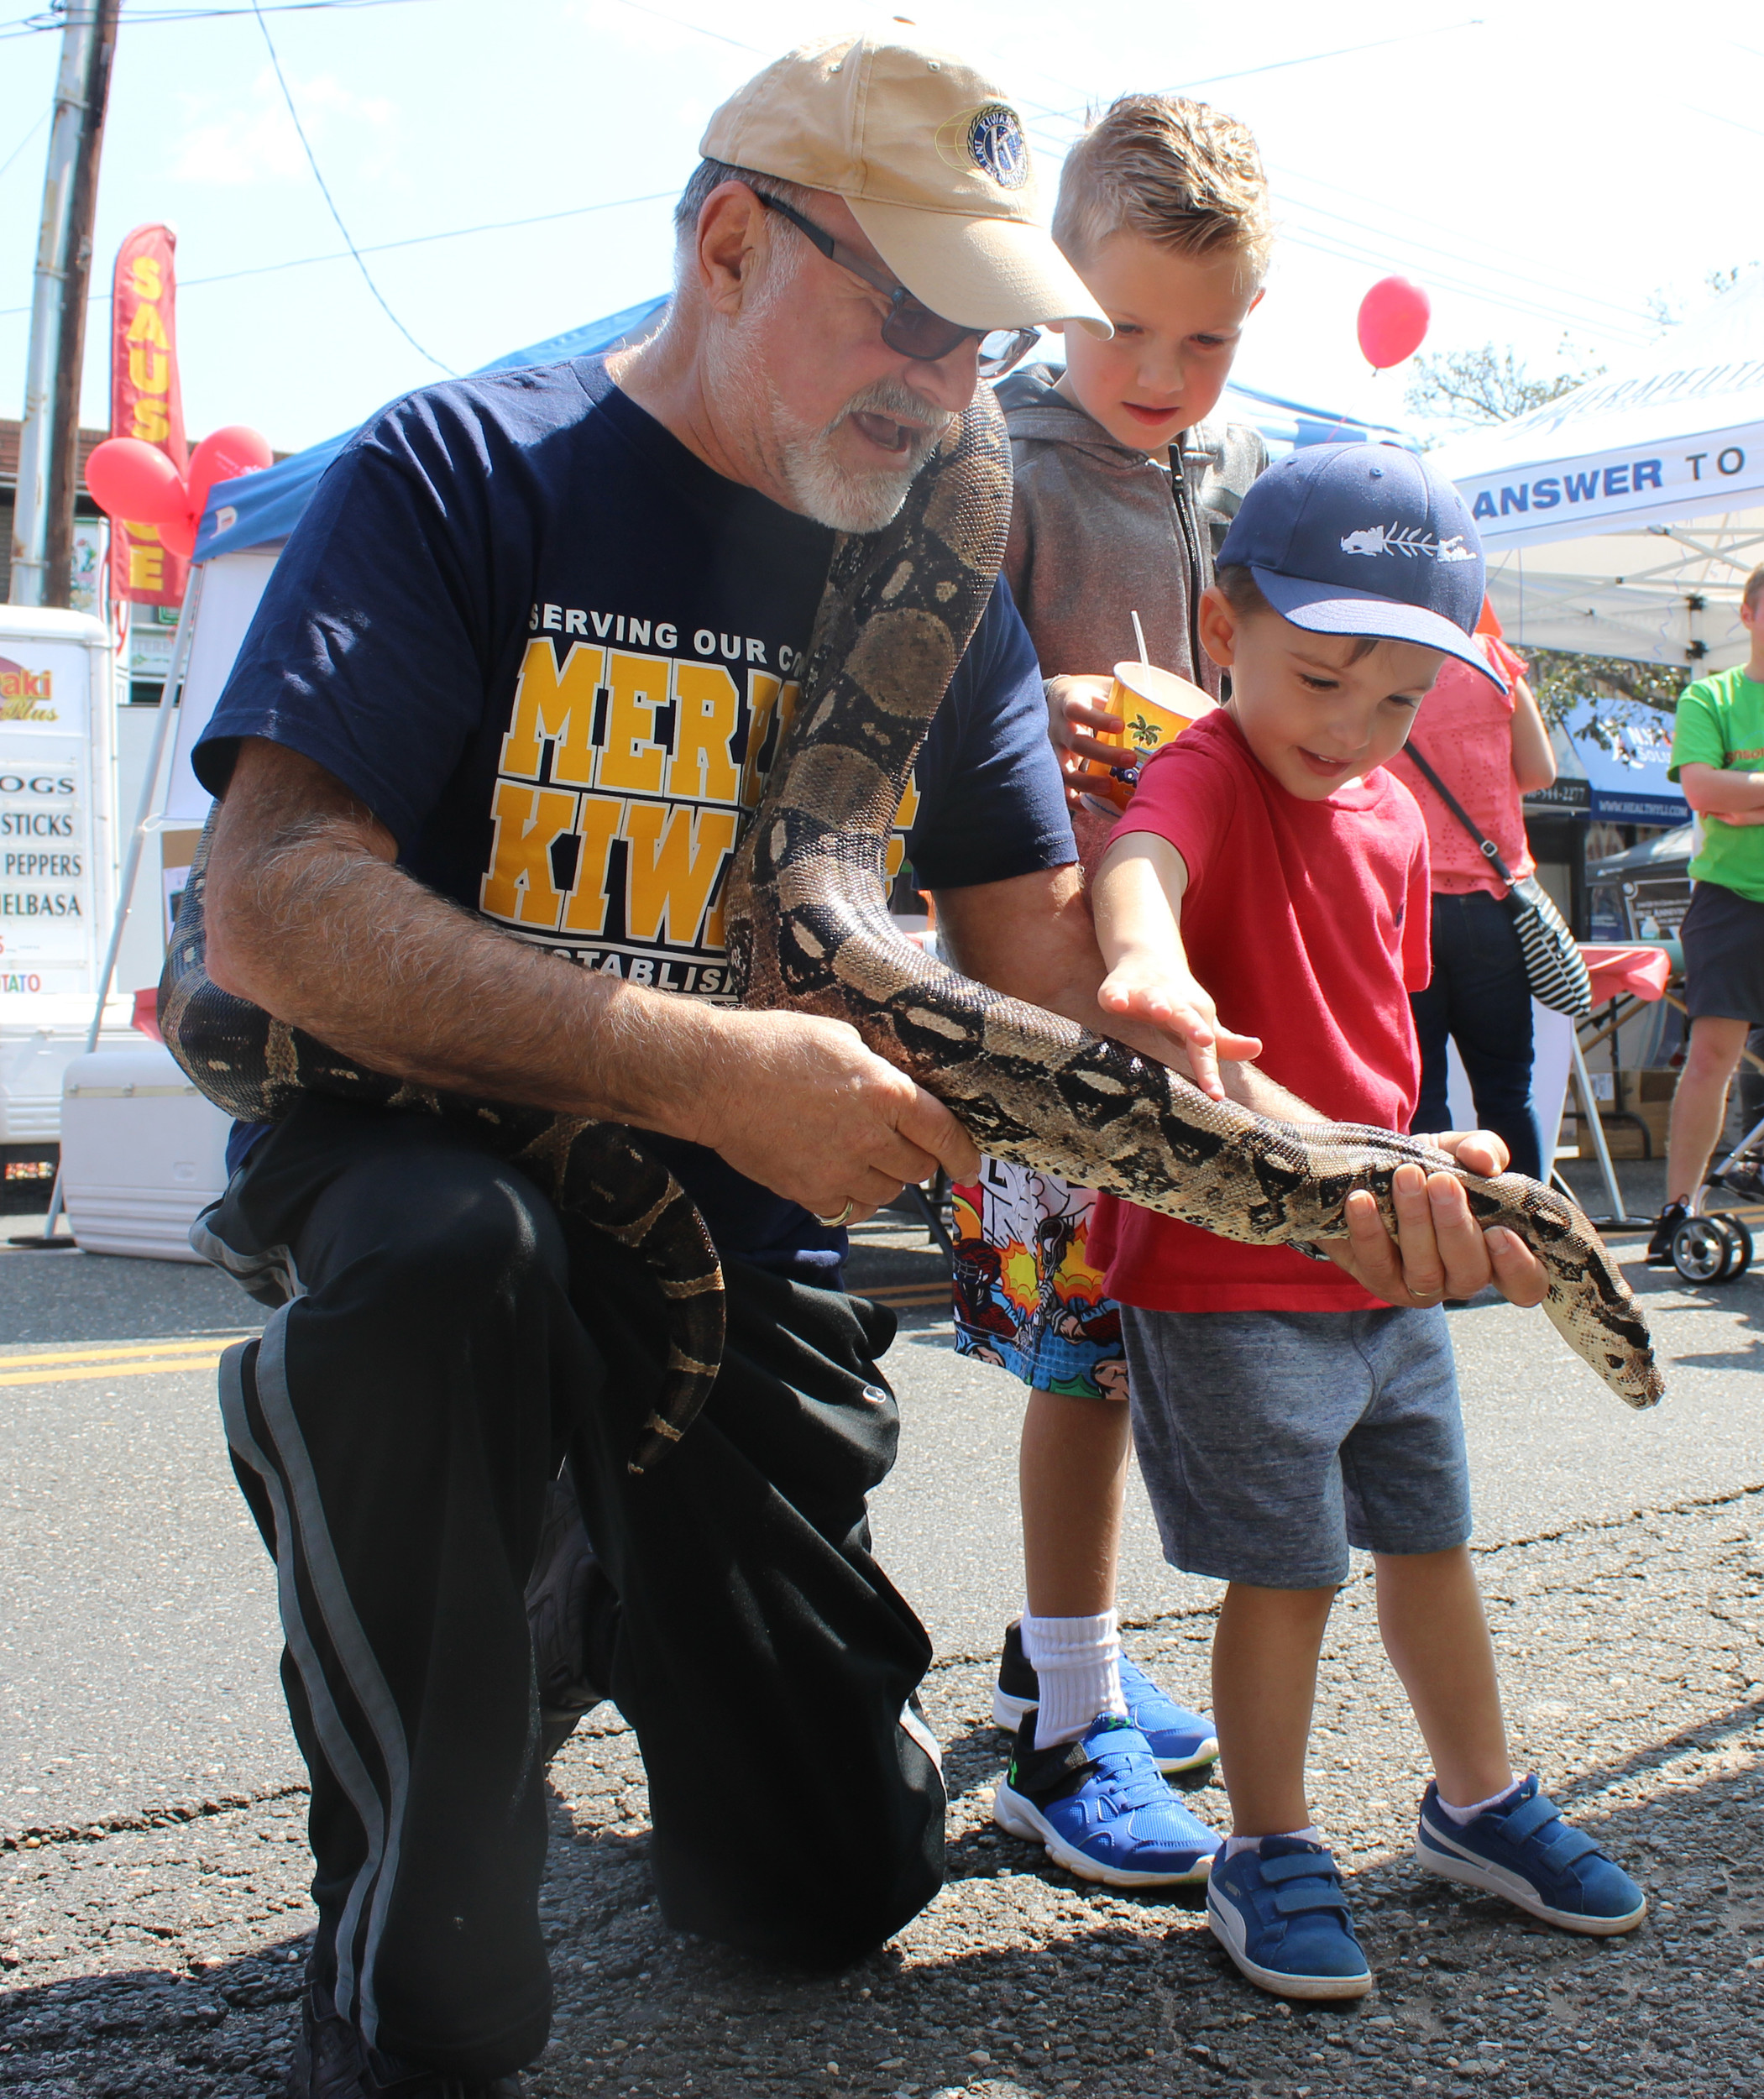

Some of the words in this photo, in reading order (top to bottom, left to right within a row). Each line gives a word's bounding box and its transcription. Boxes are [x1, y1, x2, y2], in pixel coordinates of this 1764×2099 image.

[126, 255, 171, 592] SAUSE
[1472, 458, 1663, 521] ANSWER
[1685, 446, 1746, 481] TO
[529, 602, 678, 649] SERVING
[693, 629, 767, 664] OUR
[0, 668, 52, 699] aki
[0, 775, 75, 795] OGS
[1, 812, 74, 836] STICKS
[5, 852, 82, 877] PEPPERS
[0, 893, 81, 916] ELBASA
[0, 973, 41, 992] TATO
